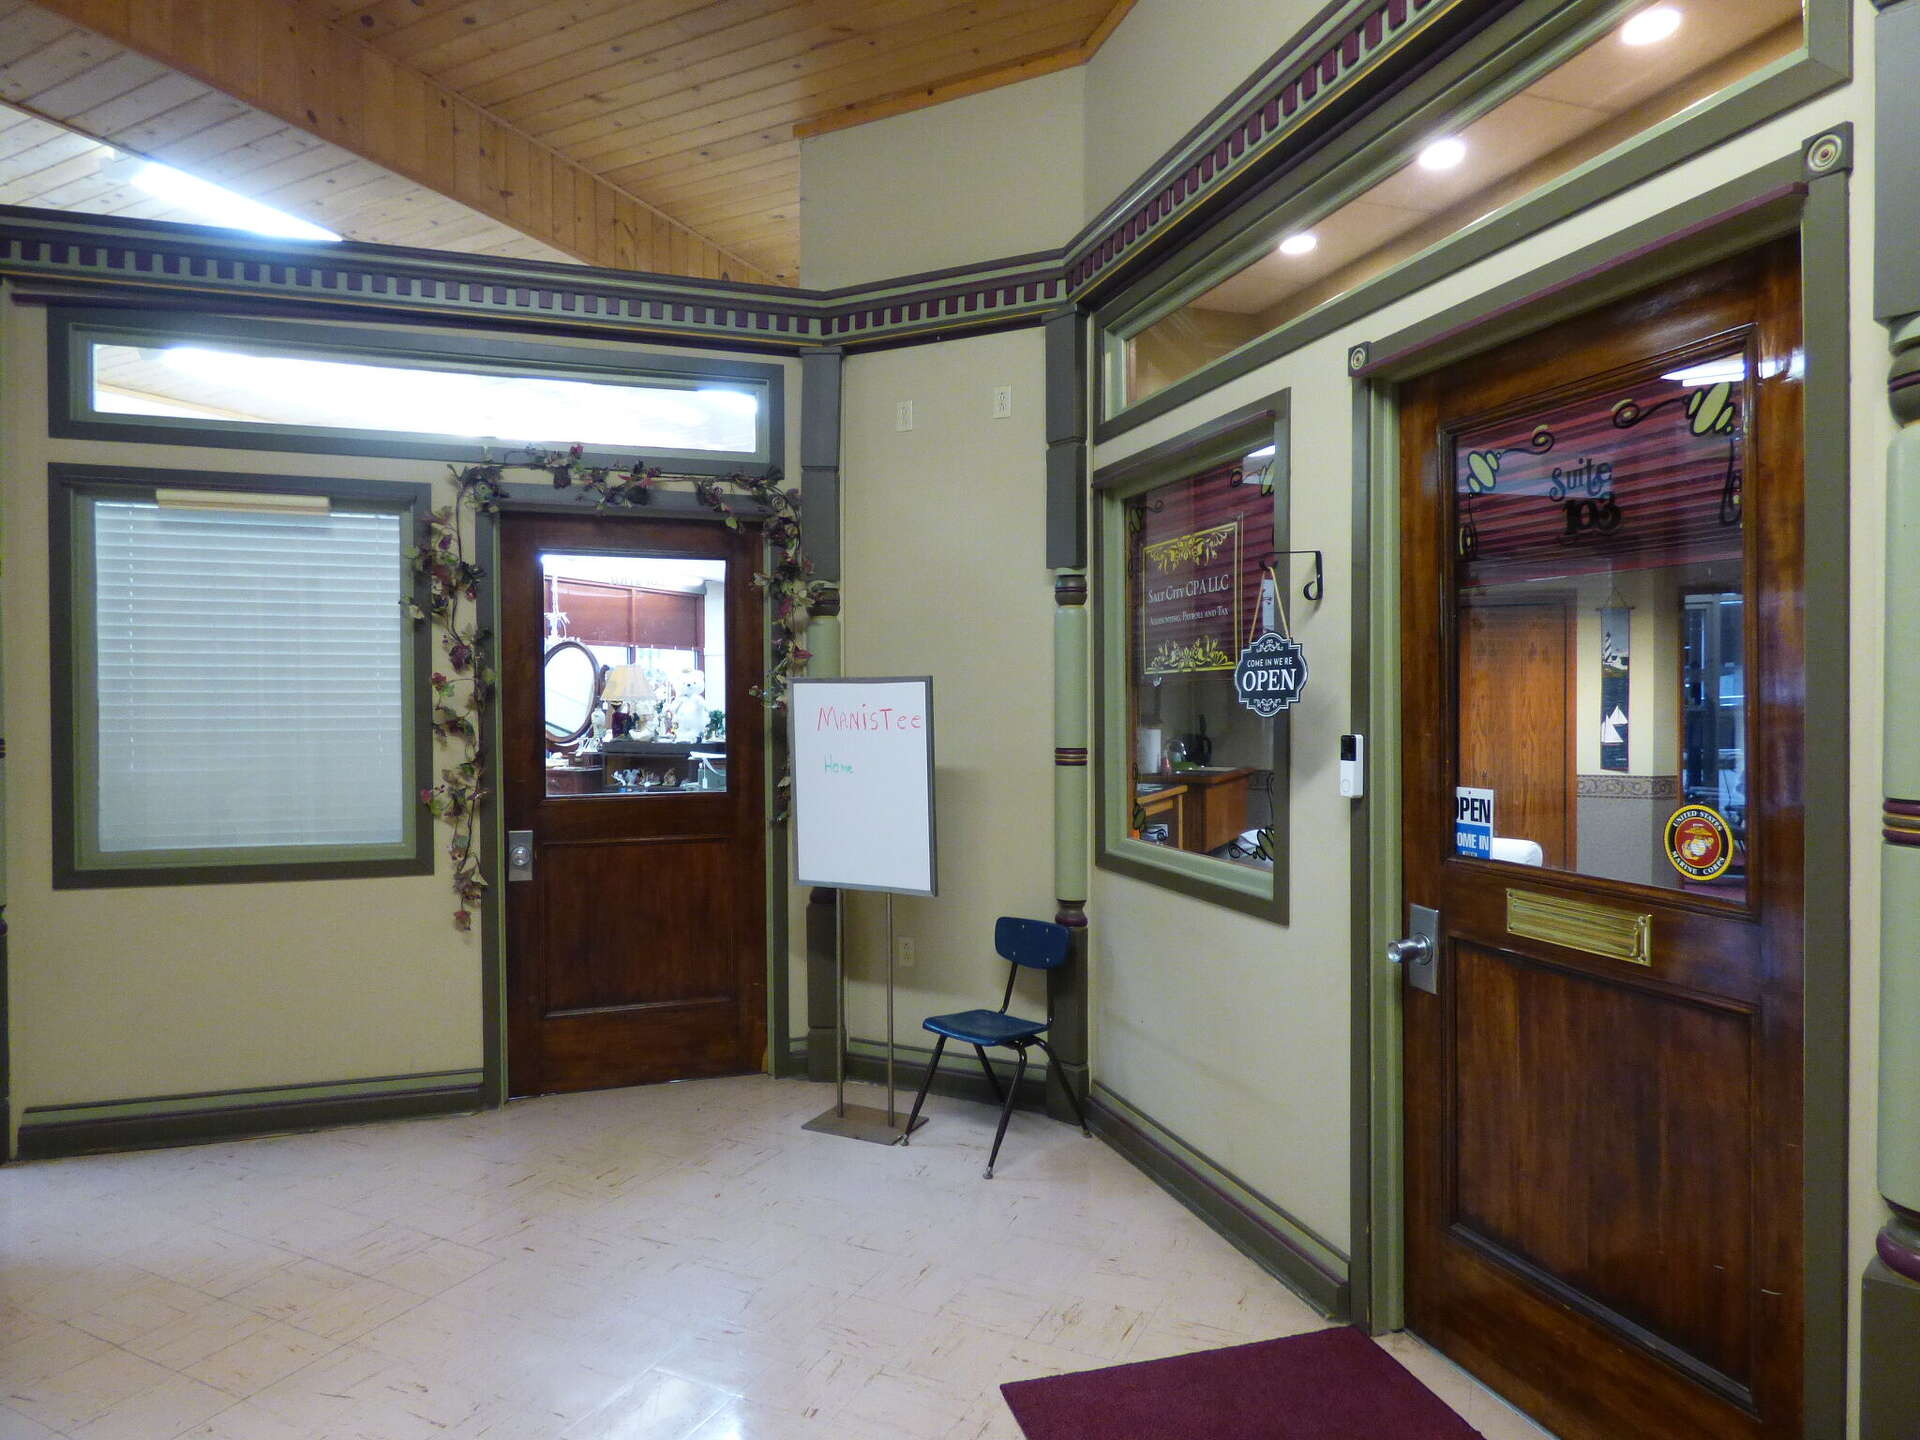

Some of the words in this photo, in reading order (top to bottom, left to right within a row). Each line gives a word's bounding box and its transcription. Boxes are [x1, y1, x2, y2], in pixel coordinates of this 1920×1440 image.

[1550, 458, 1612, 500] Suite
[1562, 492, 1621, 536] 103
[1186, 580, 1207, 597] CPA
[1208, 574, 1229, 593] LLC
[1247, 659, 1264, 668] COME
[1264, 658, 1272, 667] IN
[1242, 668, 1297, 692] OPEN
[1673, 811, 1697, 827] UNITED
[1700, 811, 1722, 831] STATES
[1478, 835, 1490, 851] IN
[1672, 851, 1697, 874] MARINE
[1703, 857, 1725, 874] CORPS
